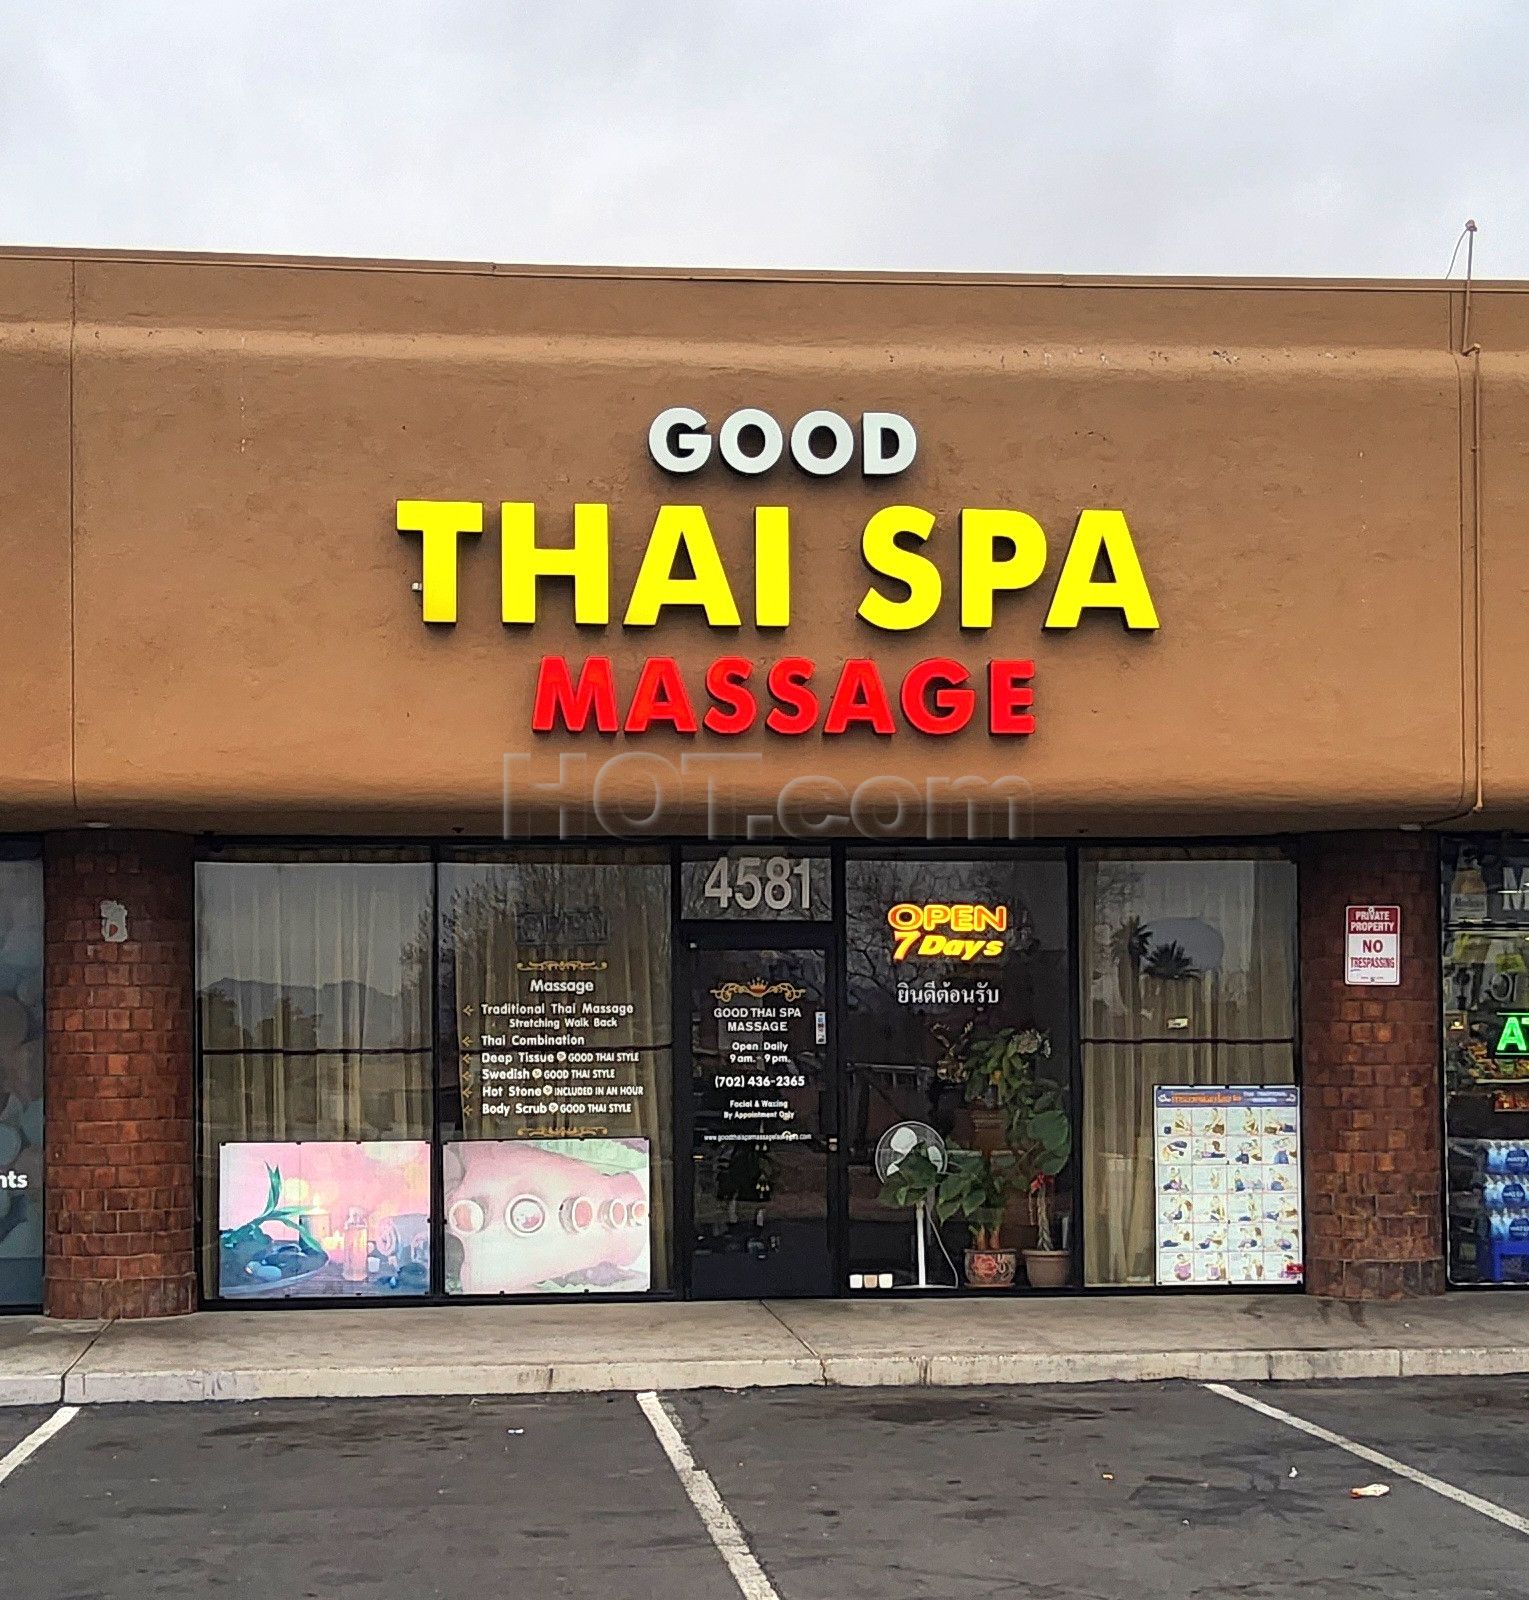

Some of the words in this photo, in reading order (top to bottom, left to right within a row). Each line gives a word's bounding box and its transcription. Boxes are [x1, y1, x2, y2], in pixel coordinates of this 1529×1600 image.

[648, 408, 918, 476] GOOD
[396, 500, 790, 628] THAI
[856, 505, 1161, 632] SPA
[531, 655, 1036, 736] MASSAGE
[704, 856, 810, 910] 4581
[887, 903, 1007, 932] OPEN
[1355, 911, 1390, 921] PRIVATE
[1350, 921, 1395, 932] PROPERTY
[893, 931, 921, 961] 7
[918, 935, 1004, 960] Days
[1362, 939, 1384, 954] NO
[1350, 957, 1395, 969] TRESPASSING
[529, 979, 595, 995] Massage
[897, 980, 1000, 1004] ยินดีต้อนรับ
[481, 1003, 546, 1016] Traditional
[551, 1003, 576, 1015] Thai
[582, 1003, 634, 1017] Massage
[713, 1007, 749, 1018] GOOD
[750, 1007, 776, 1018] THAI
[779, 1007, 802, 1018] SPA
[509, 1018, 560, 1029] Stretching
[565, 1018, 590, 1028] Walk
[594, 1017, 618, 1028] Back
[727, 1021, 789, 1032] MASSAGE
[481, 1035, 506, 1047] Thai
[511, 1034, 585, 1046] Combination
[731, 1041, 759, 1052] Open
[763, 1041, 789, 1052] Daily
[481, 1052, 513, 1065] Deep
[518, 1052, 554, 1063] Tissue
[568, 1052, 593, 1063] GOOD
[595, 1052, 615, 1062] THAI
[616, 1052, 640, 1062] STYLE
[482, 1068, 530, 1080] Swedish
[544, 1069, 569, 1080] GOOD
[571, 1069, 590, 1079] THAI
[592, 1069, 616, 1079] STYLE
[714, 1075, 745, 1088] (702)
[747, 1075, 805, 1087] 436-2365
[482, 1086, 503, 1097] Hot
[508, 1086, 542, 1097] Stone
[554, 1086, 593, 1096] INCLUDED
[595, 1086, 604, 1096] IN
[606, 1086, 618, 1096] AN
[620, 1086, 644, 1096] HOUR
[482, 1103, 511, 1117] Body
[515, 1103, 548, 1114] Scrub
[559, 1104, 586, 1114] GOOD
[588, 1103, 607, 1113] THAI
[609, 1103, 632, 1113] STYLE
[729, 1100, 753, 1108] Facial
[754, 1100, 760, 1108] &
[761, 1100, 788, 1109] Waxing
[723, 1111, 733, 1120] By
[734, 1110, 778, 1119] Appointment
